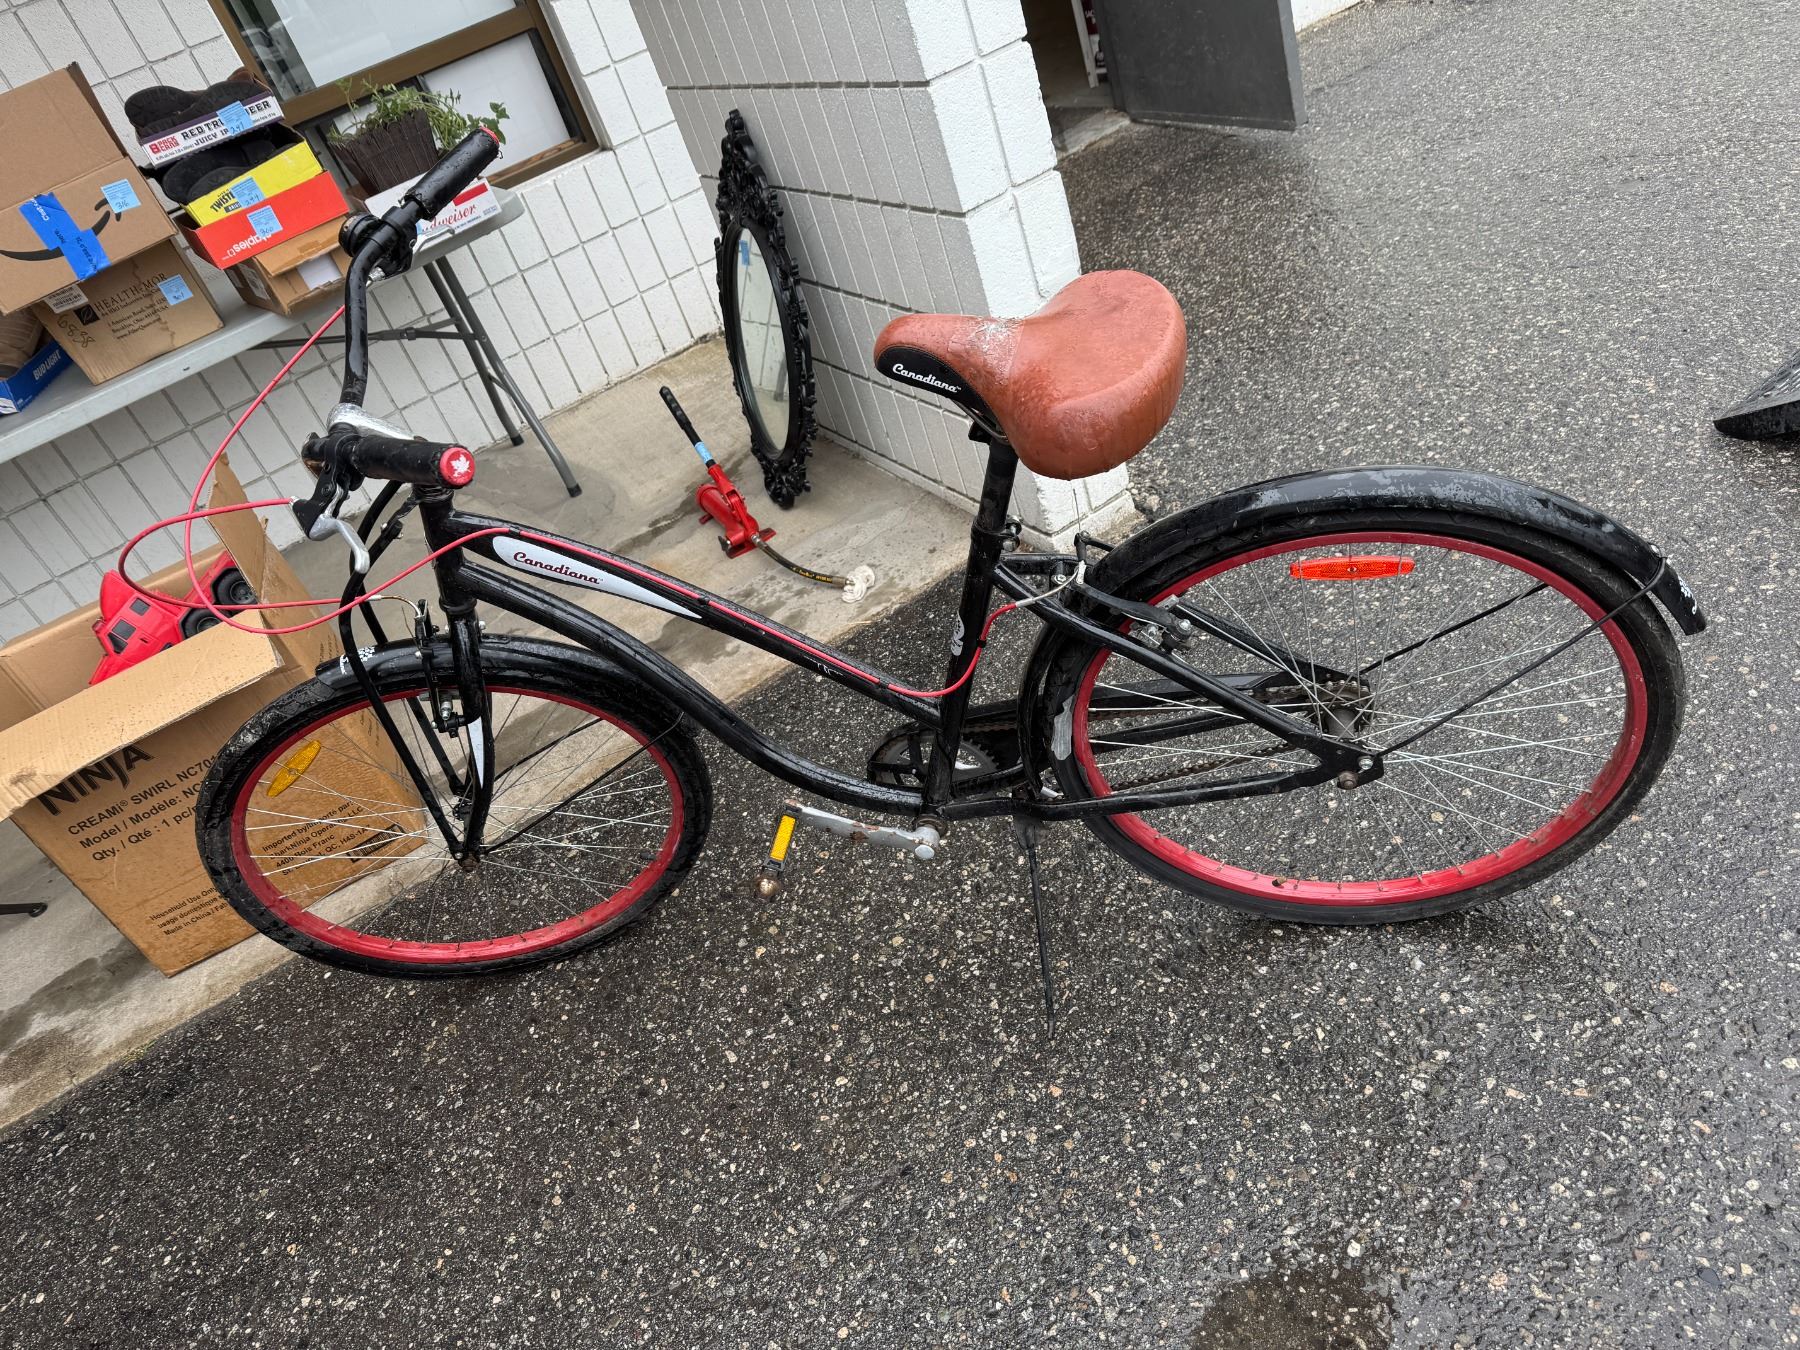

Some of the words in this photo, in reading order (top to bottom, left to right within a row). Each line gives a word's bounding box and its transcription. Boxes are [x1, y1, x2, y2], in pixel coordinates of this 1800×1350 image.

[181, 126, 204, 140] RED
[194, 132, 217, 146] JUICY
[220, 128, 229, 136] IP
[149, 143, 160, 154] 8
[421, 204, 477, 231] dweiser
[891, 363, 959, 394] Canadiana
[513, 551, 601, 586] Canadiana
[35, 744, 155, 817] NINJA
[132, 777, 176, 806] SWIRL
[79, 825, 122, 849] Model
[129, 795, 183, 826] Modèle:
[182, 781, 203, 799] NC
[92, 847, 121, 861] Qty.
[128, 828, 152, 845] Qté
[162, 818, 171, 828] 1
[261, 828, 300, 852] Imported
[312, 834, 336, 850] Franc
[149, 901, 188, 921] Household
[187, 895, 201, 904] Use
[201, 887, 218, 897] Only
[157, 916, 179, 929] usage
[179, 897, 219, 919] domestique
[163, 924, 184, 936] Made
[183, 920, 191, 928] in
[191, 911, 212, 924] China
